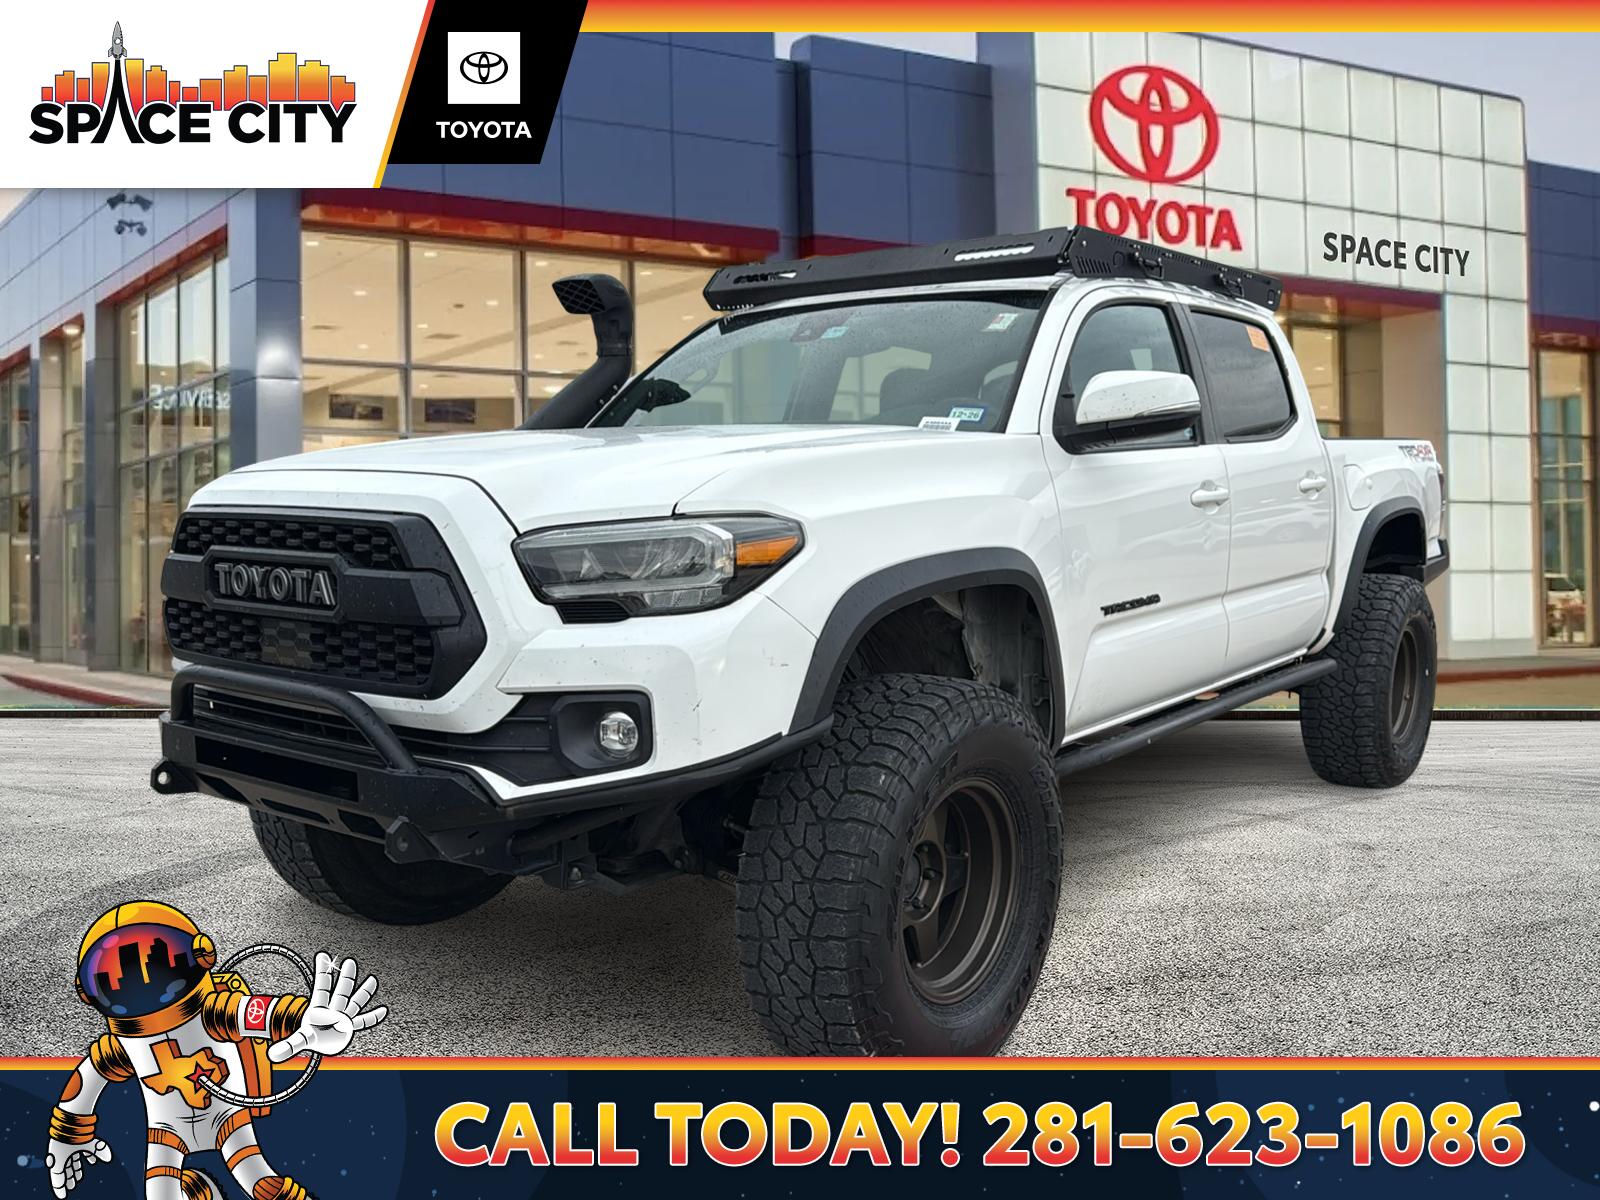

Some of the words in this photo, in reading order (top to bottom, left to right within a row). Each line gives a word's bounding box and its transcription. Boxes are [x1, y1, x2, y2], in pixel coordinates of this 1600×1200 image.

[1066, 187, 1242, 251] TOYOTA
[1323, 231, 1407, 270] SPACE
[1414, 244, 1470, 277] CITY
[214, 562, 336, 606] TOYOTA
